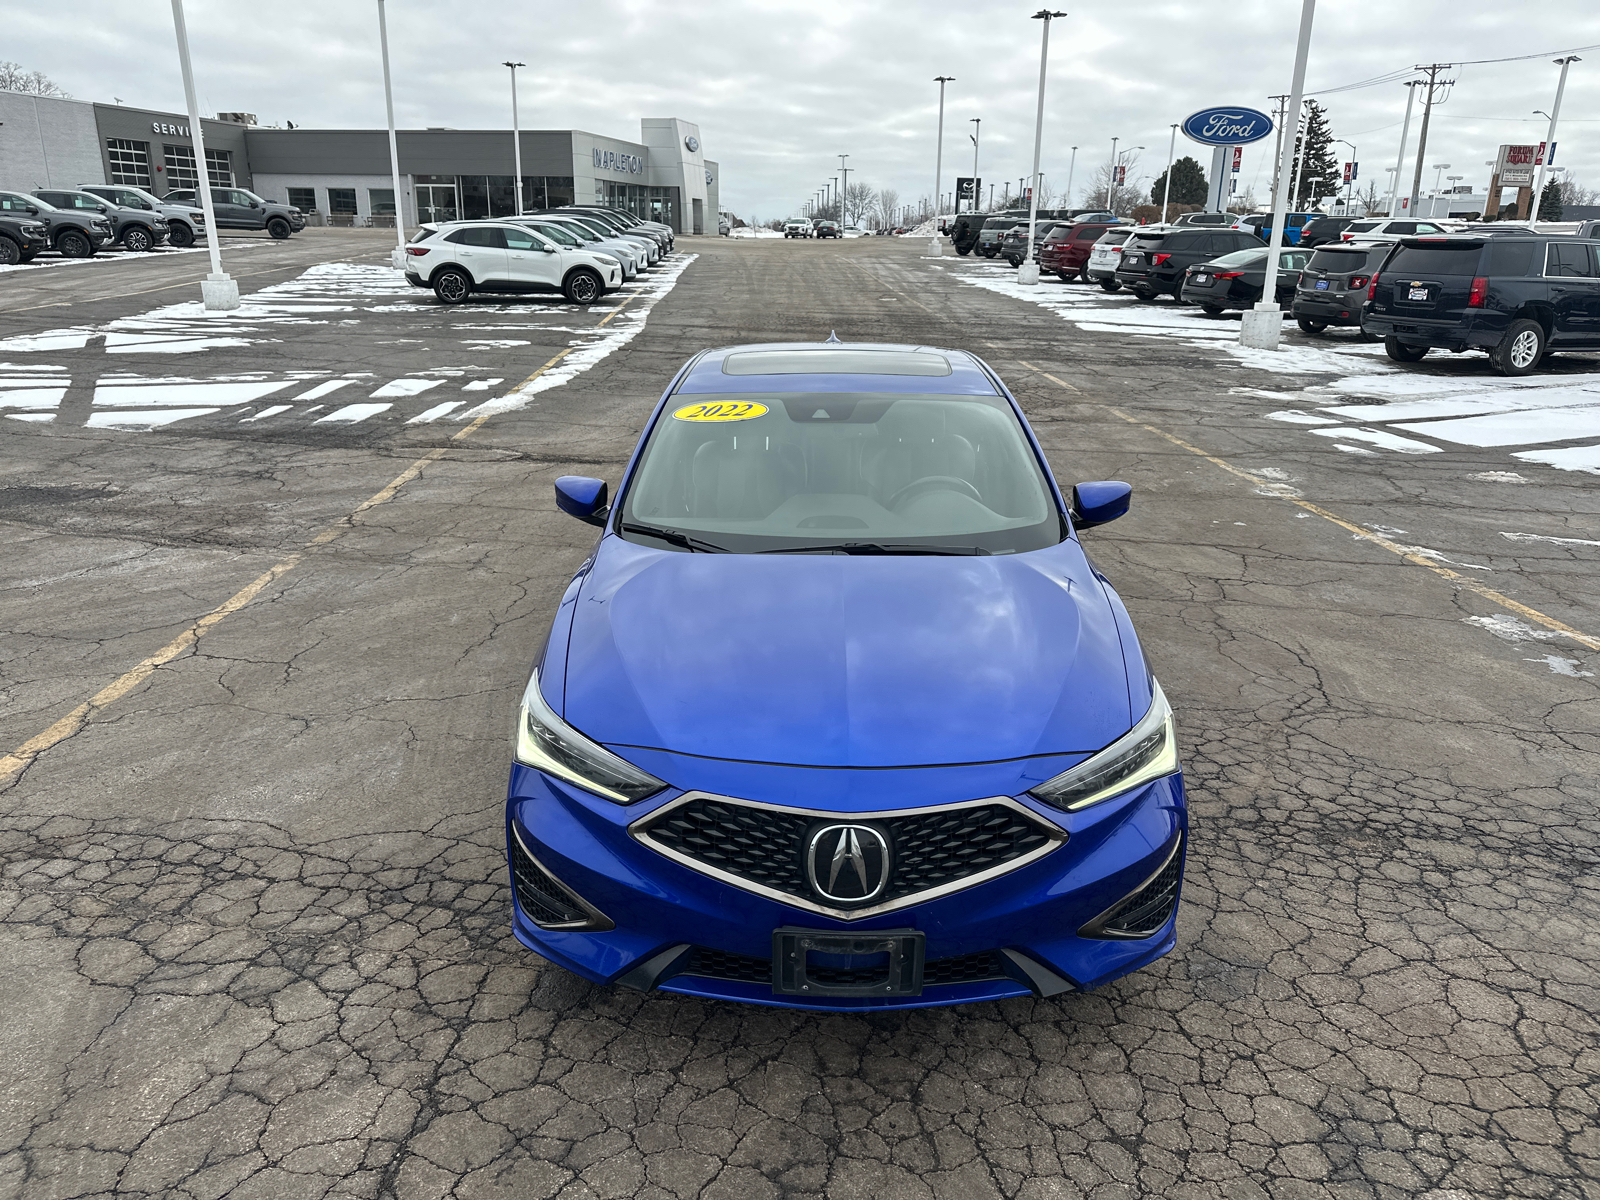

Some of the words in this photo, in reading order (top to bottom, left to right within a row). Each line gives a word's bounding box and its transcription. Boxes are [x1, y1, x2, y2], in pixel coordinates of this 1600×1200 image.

[153, 122, 204, 138] SERVIE
[1202, 113, 1256, 137] Ford
[1508, 146, 1534, 155] FORUM
[593, 147, 644, 175] NAPLETON
[685, 404, 754, 418] 2022
